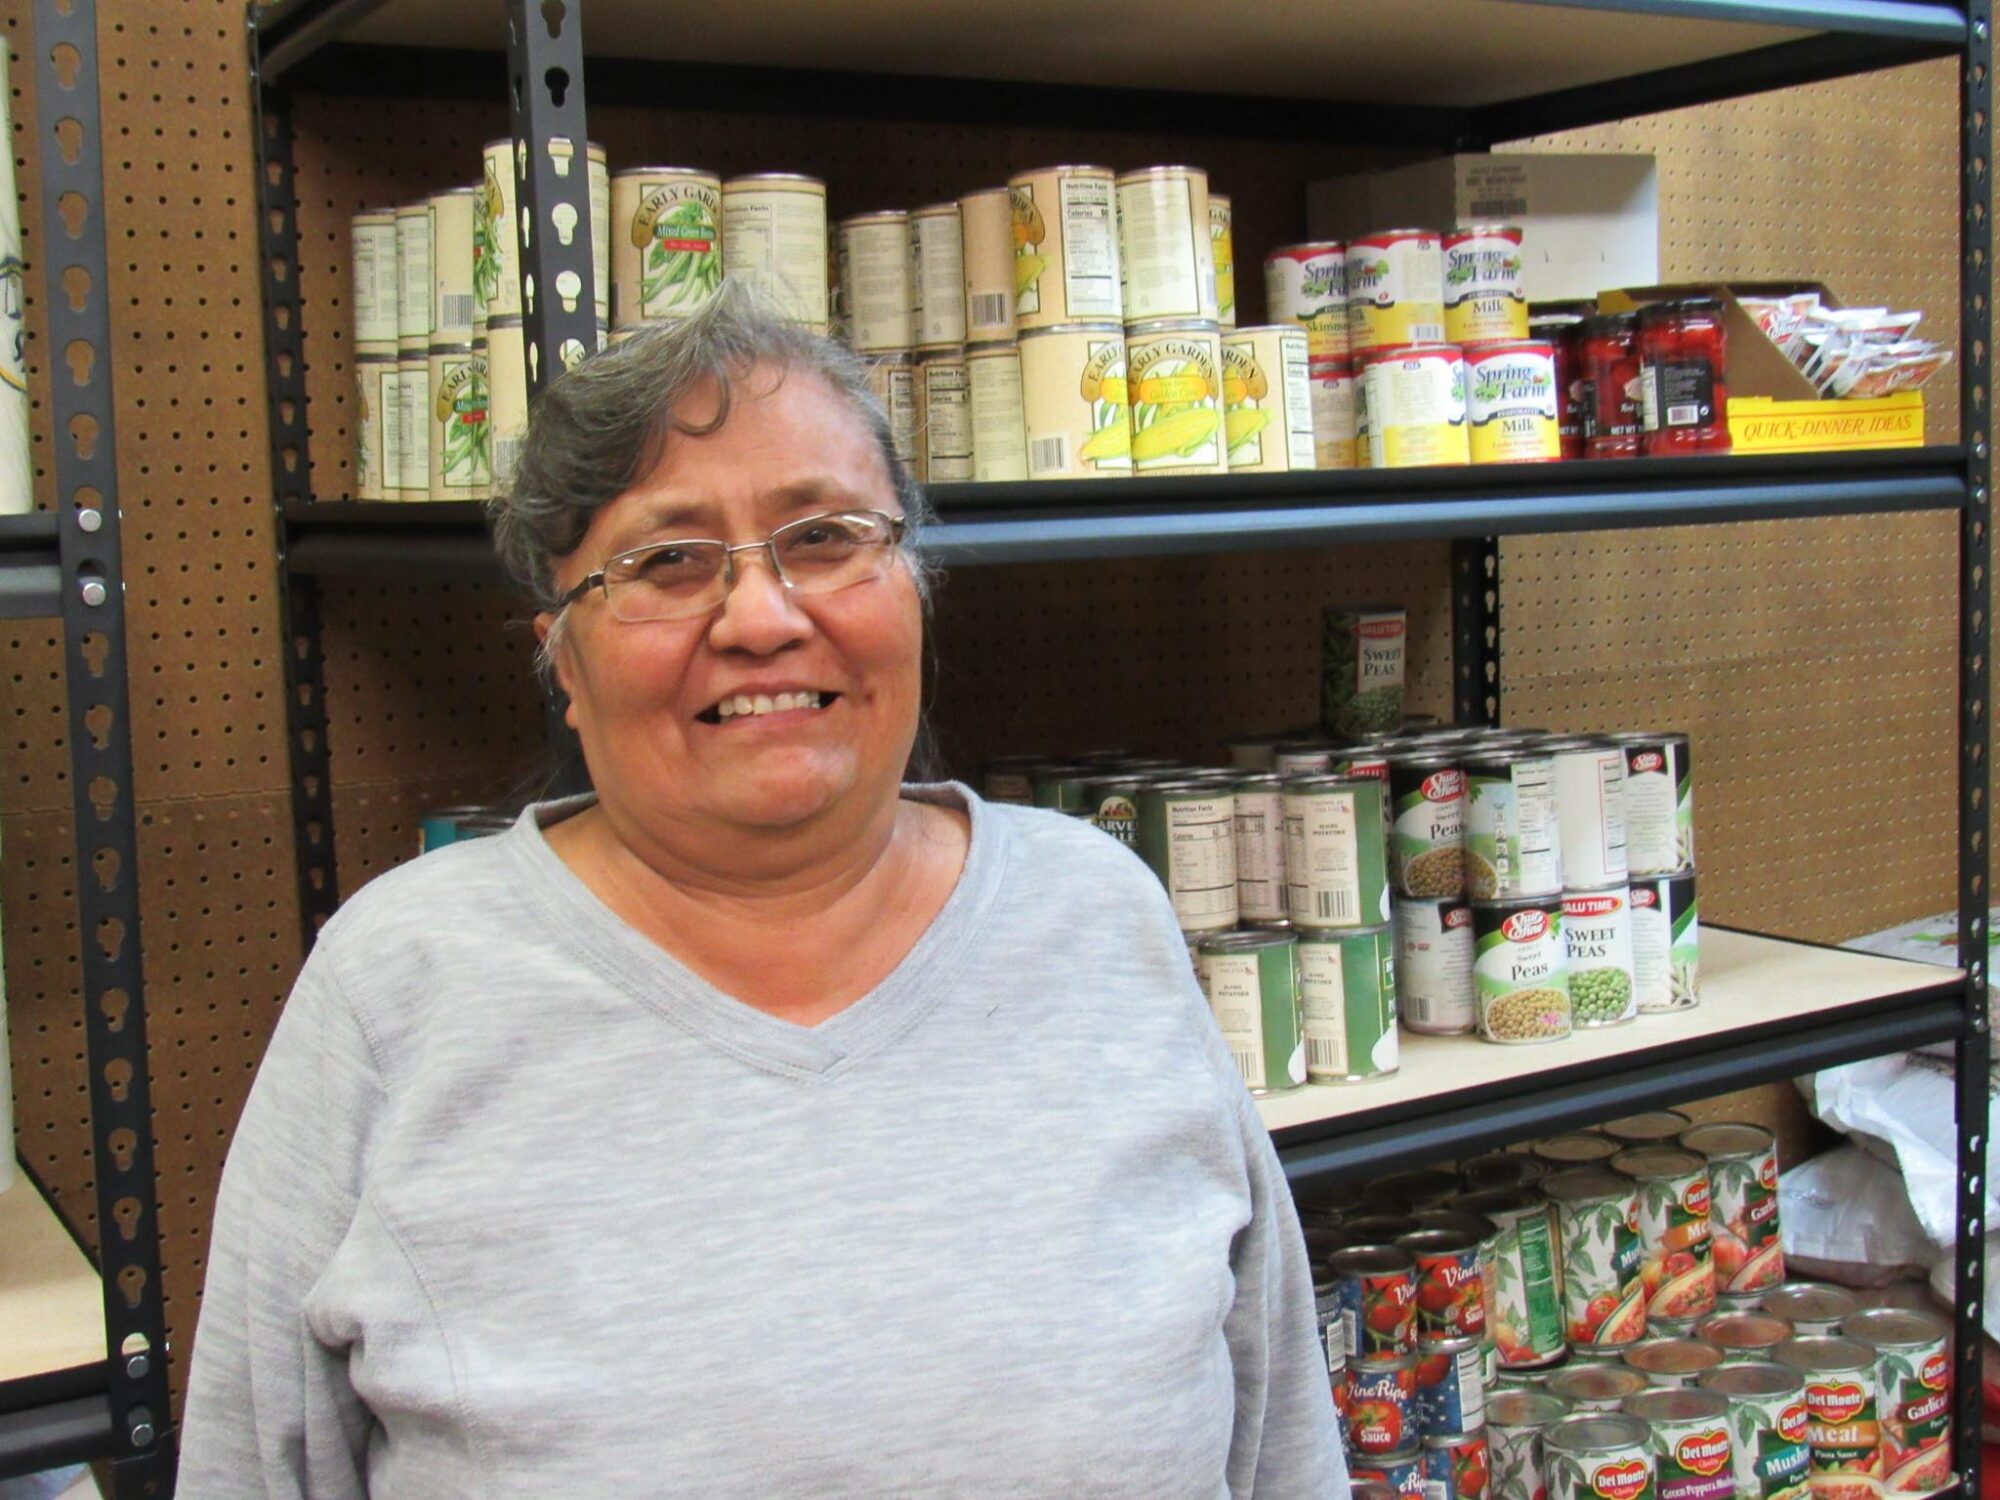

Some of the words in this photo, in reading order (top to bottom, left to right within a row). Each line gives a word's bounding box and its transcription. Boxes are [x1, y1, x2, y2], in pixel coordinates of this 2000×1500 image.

[1447, 249, 1503, 271] Spring
[1471, 264, 1516, 283] Farm
[1473, 299, 1503, 312] Milk
[1128, 347, 1161, 385] EARLY
[1165, 343, 1213, 379] GARDEN
[1476, 364, 1533, 388] Spring
[1500, 382, 1546, 400] Farm
[1502, 418, 1535, 433] Milk
[1744, 418, 1867, 442] QUICK-DINNER
[1869, 413, 1913, 433] IDEAS
[1364, 663, 1397, 677] PEAS
[1172, 805, 1197, 813] Nutrition
[1172, 832, 1194, 840] Calories
[1430, 823, 1466, 839] Peas
[1587, 898, 1613, 912] TIME
[1565, 927, 1616, 942] SWEET
[1566, 943, 1607, 958] PEAS
[1511, 963, 1549, 981] Peas
[1375, 1379, 1408, 1403] Ripe
[1808, 1393, 1826, 1406] Del
[1827, 1392, 1861, 1406] Monte
[1360, 1429, 1391, 1443] Sauce
[1808, 1425, 1858, 1443] Meat
[1681, 1447, 1700, 1460] Del
[1701, 1440, 1729, 1457] Monte
[1815, 1449, 1835, 1458] Pasta
[1836, 1449, 1858, 1458] Sauce
[1598, 1474, 1617, 1488] Del
[1618, 1469, 1645, 1485] Monte
[1662, 1486, 1686, 1500] Green
